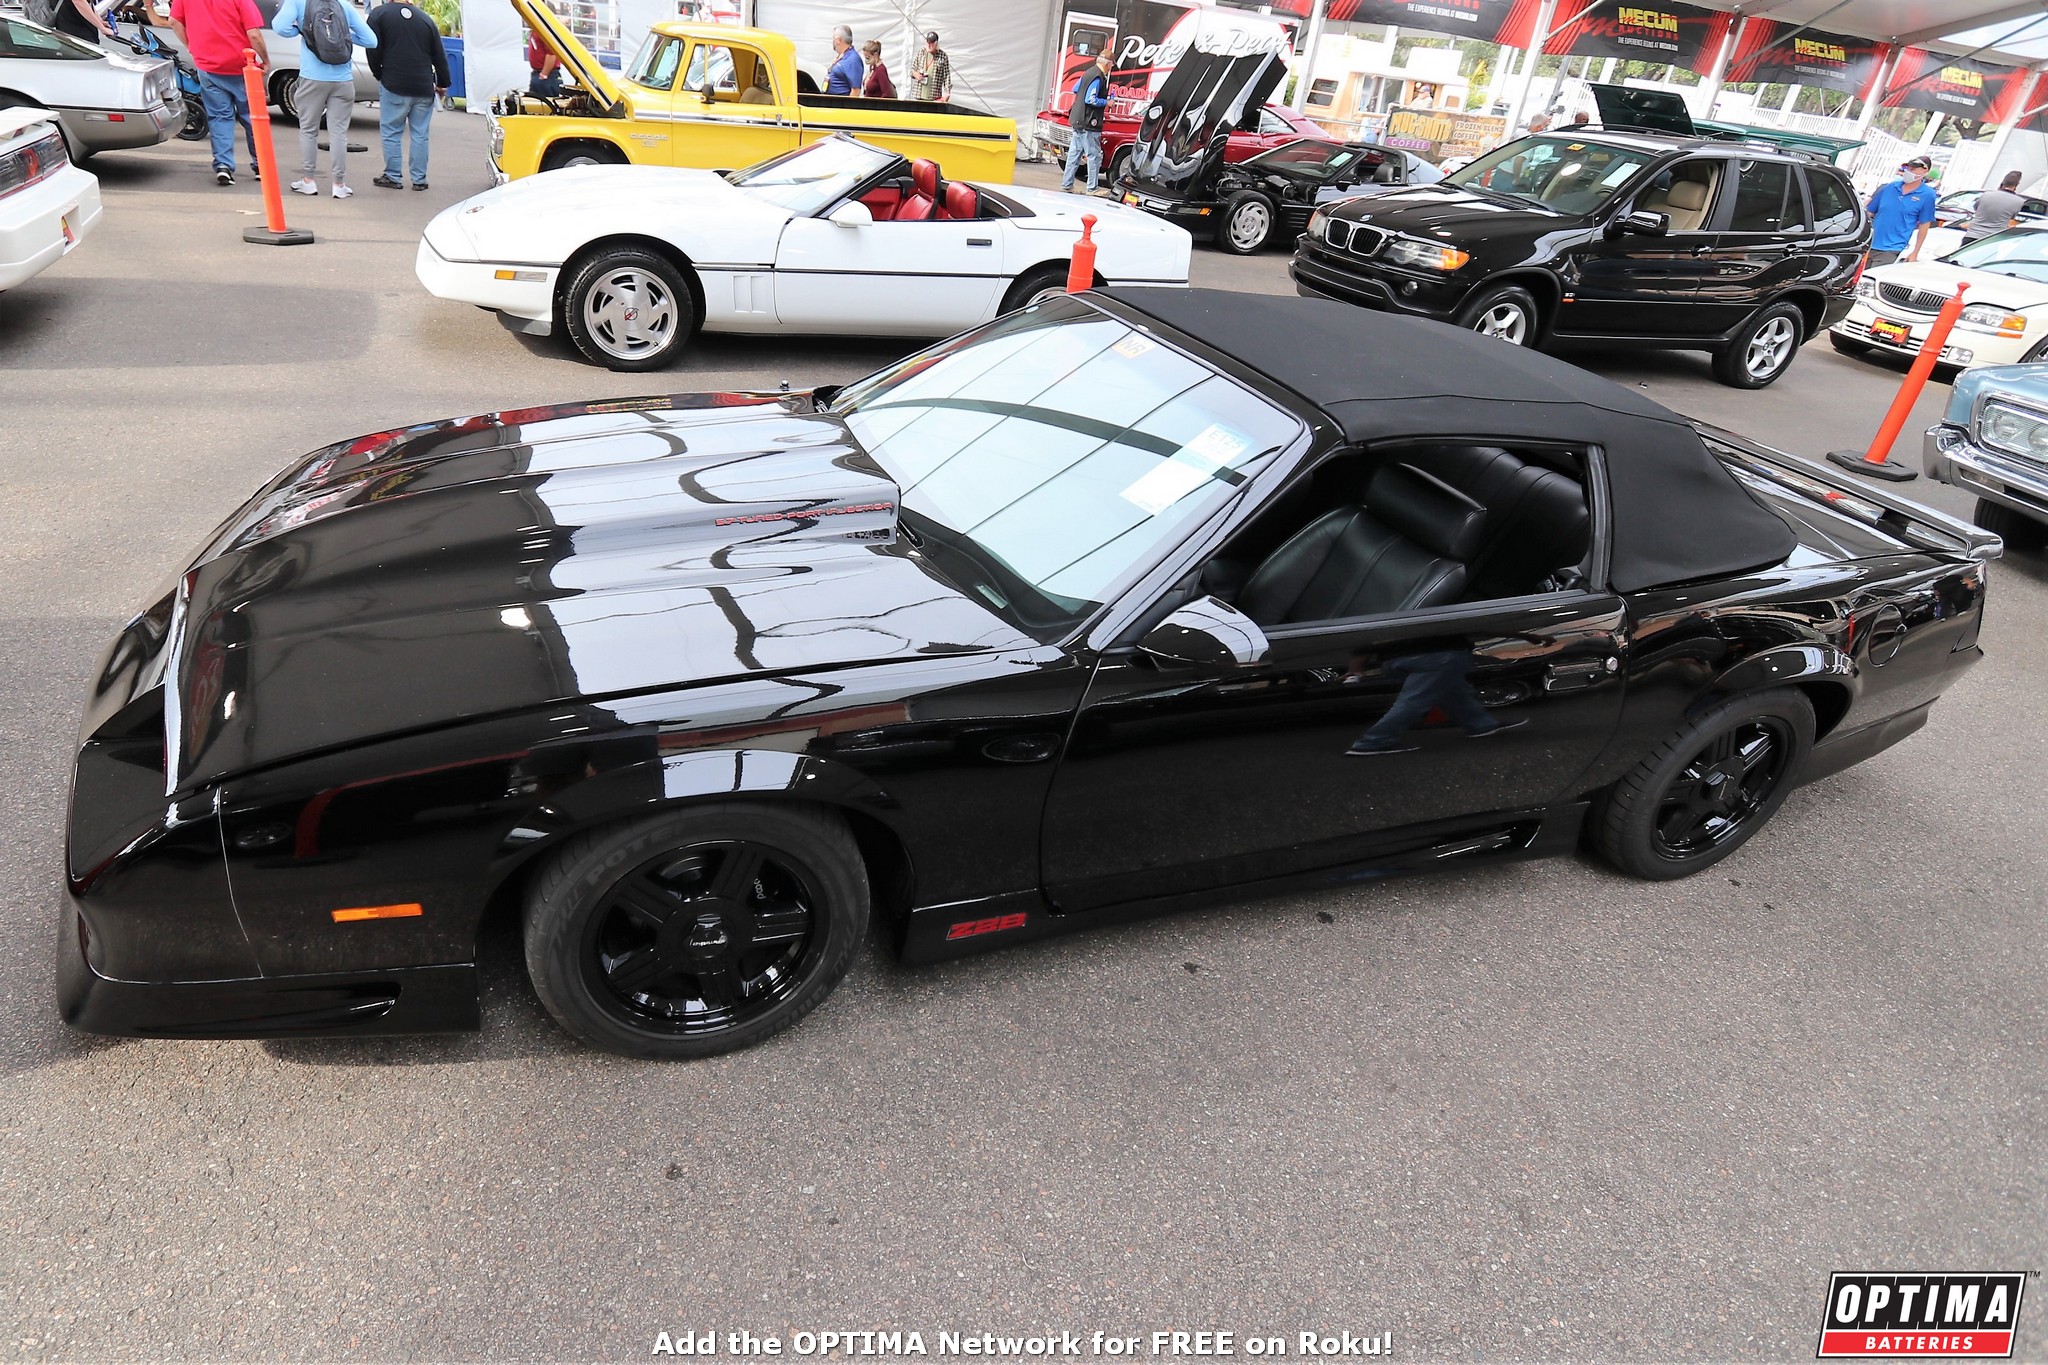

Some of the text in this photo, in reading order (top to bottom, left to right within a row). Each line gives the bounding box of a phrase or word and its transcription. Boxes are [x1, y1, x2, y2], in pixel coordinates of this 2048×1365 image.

[1618, 7, 1678, 32] MECUM
[1116, 35, 1185, 69] Pete
[1794, 38, 1846, 61] MECUM
[1940, 67, 1983, 88] MECUM
[1391, 138, 1427, 150] COFFEE
[738, 513, 784, 525] TUNED
[786, 508, 823, 519] PORT
[826, 502, 893, 516] INJECTION
[946, 912, 1027, 941] Z28
